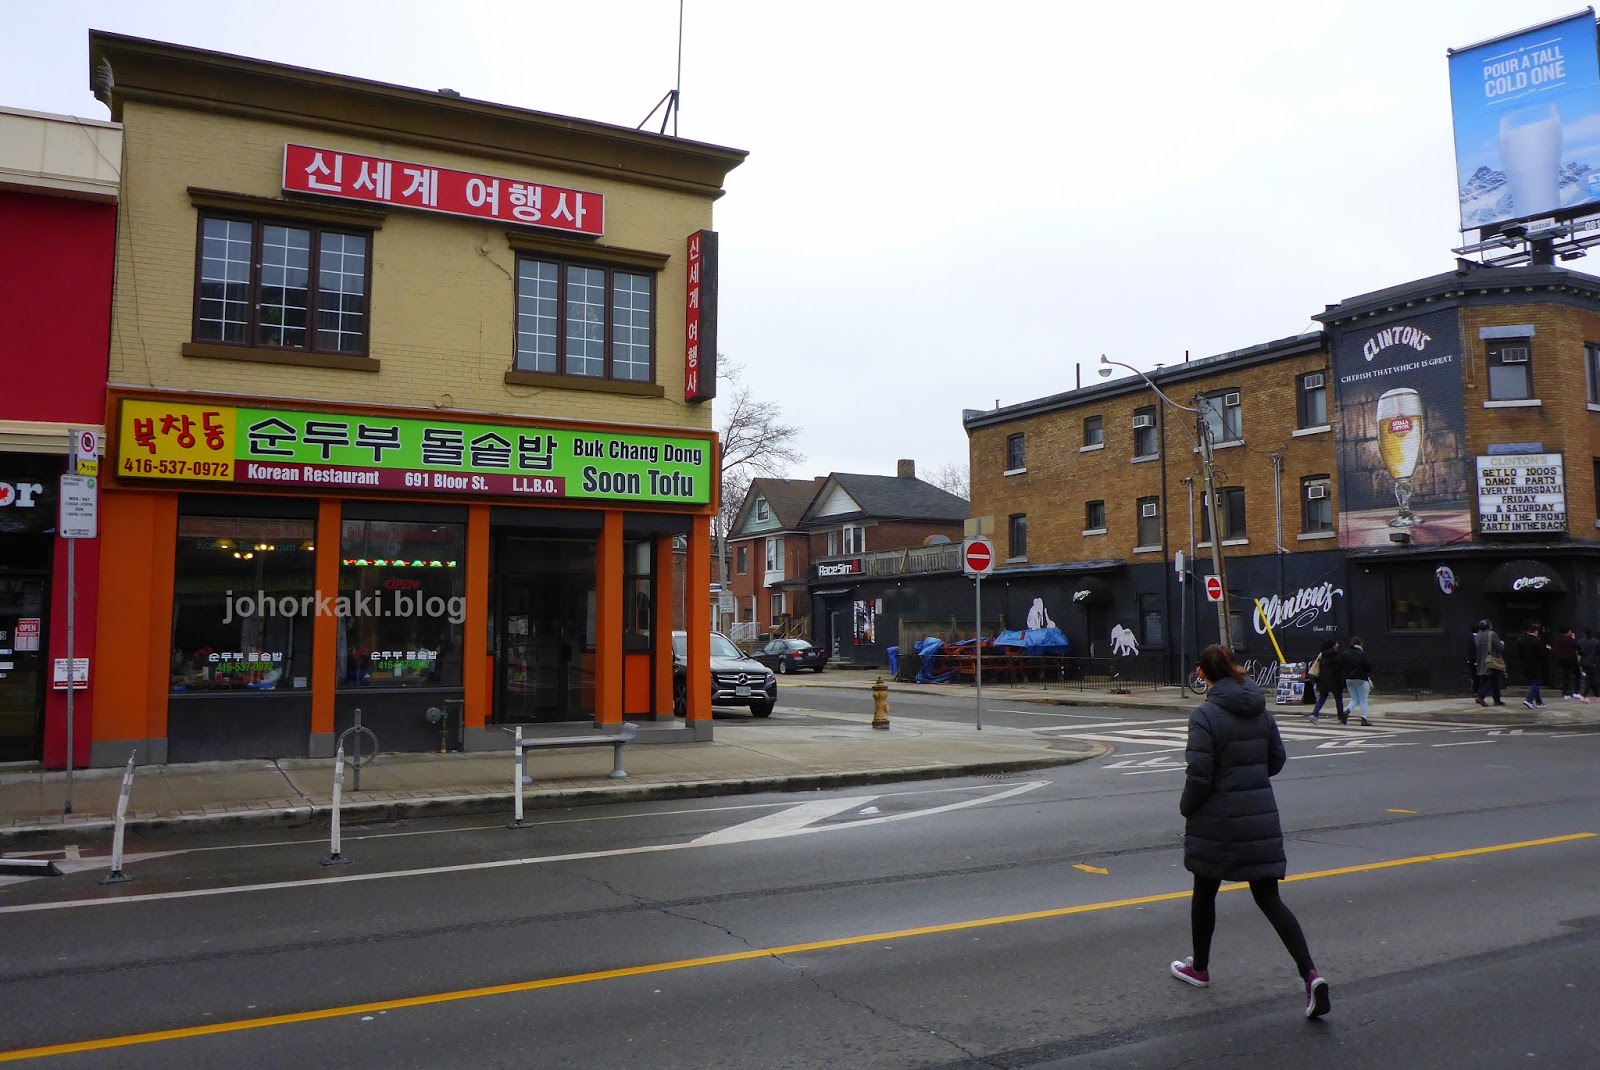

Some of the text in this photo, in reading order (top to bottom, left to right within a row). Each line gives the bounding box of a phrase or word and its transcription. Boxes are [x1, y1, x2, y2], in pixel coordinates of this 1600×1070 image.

[1483, 46, 1564, 80] POUR A TALL
[1485, 71, 1528, 98] COLD
[1531, 60, 1566, 85] ONE
[305, 152, 586, 228] 신세계 여행사
[1530, 221, 1551, 231] astral
[687, 236, 699, 393] 신세계 여행사
[1363, 326, 1432, 361] CLINTON'S
[1341, 372, 1371, 383] CHERISH
[1373, 367, 1392, 377] THAT
[1393, 362, 1419, 373] WHICH
[1429, 355, 1453, 366] GREAT
[134, 412, 225, 454] 북창동
[249, 416, 558, 471] 순두부 돌솥밥
[573, 438, 702, 466] Buk Chang Dong
[124, 458, 229, 477] 416-537-0972
[1490, 456, 1547, 466] CLINTON'S
[248, 463, 380, 485] Korean Restaurant
[1482, 469, 1502, 477] GET
[1526, 467, 1557, 476] 2000S
[405, 472, 488, 490] 691 Bloor St.
[512, 478, 558, 493] L.L.B.O.
[582, 466, 693, 497] Soon Tofu
[1485, 476, 1555, 486] DANCE PARTY
[1480, 485, 1561, 495] EVERY THURSDAY!
[1502, 495, 1536, 504] FRIDAY
[1496, 504, 1554, 513] & SATURDAY
[1480, 514, 1498, 522] PUB
[1514, 513, 1532, 521] THE
[1535, 512, 1565, 521] FRONT
[1480, 522, 1510, 531] PARTY
[1541, 521, 1566, 530] BACK
[819, 564, 852, 576] RaceSim
[1253, 581, 1344, 634] Clinton's
[19, 624, 37, 632] OPEN
[216, 662, 274, 672] 416-537-0972
[378, 660, 430, 669] 416-537-02
